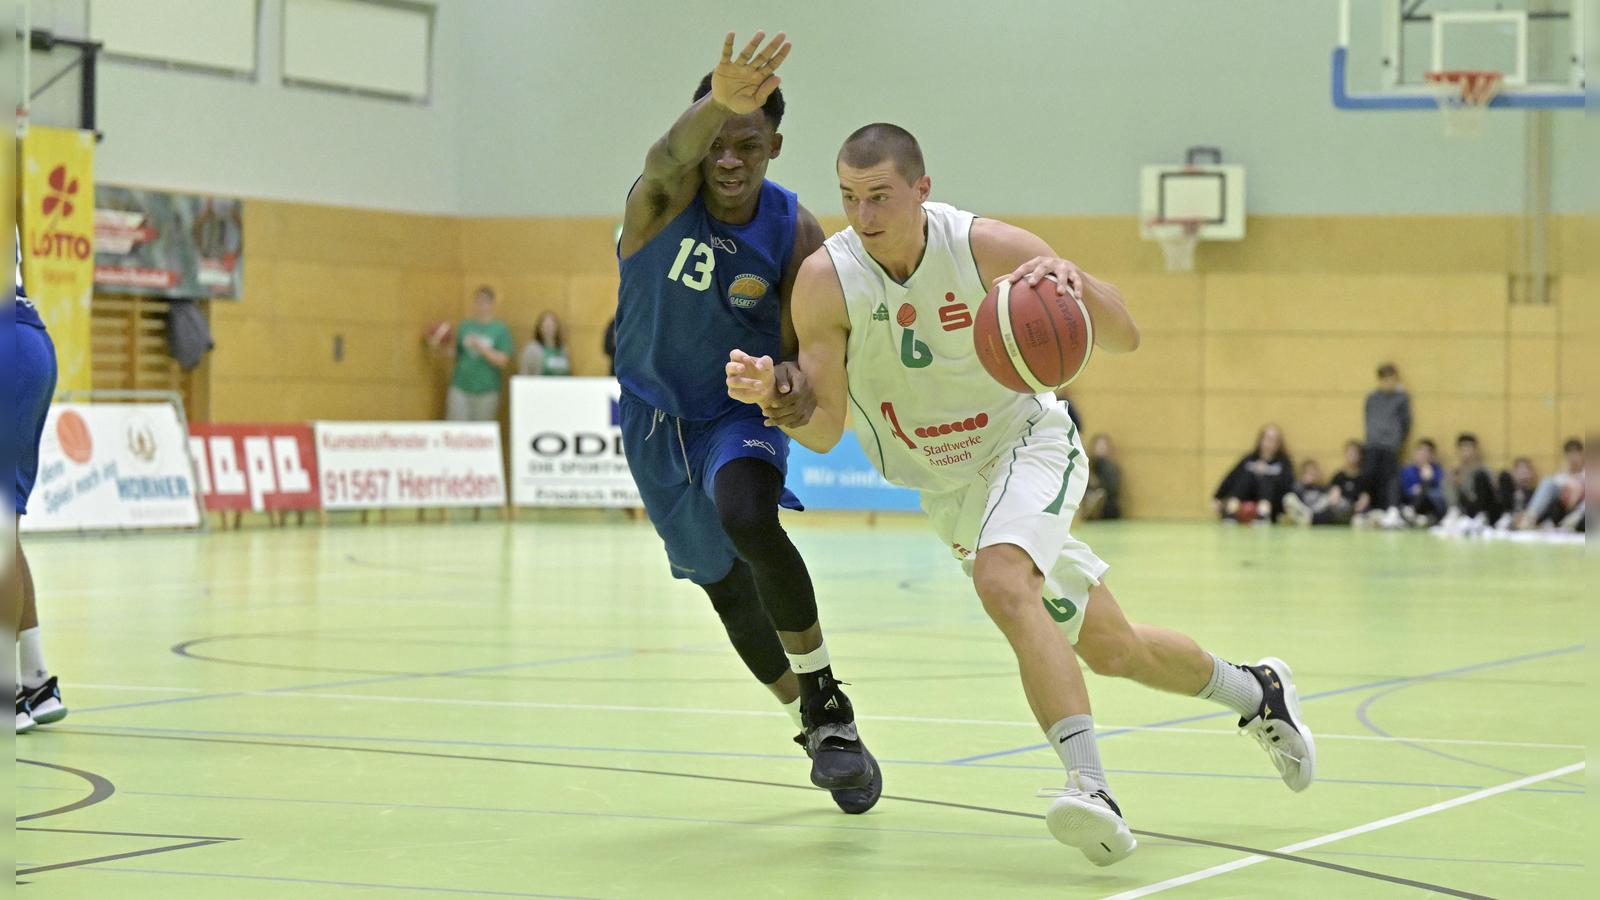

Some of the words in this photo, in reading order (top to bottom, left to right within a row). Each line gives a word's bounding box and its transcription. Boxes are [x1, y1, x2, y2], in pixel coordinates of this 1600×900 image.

[31, 232, 91, 261] LOTTO
[667, 238, 716, 291] 13
[923, 435, 983, 456] Stadtwerke
[929, 451, 972, 466] Ansbach
[325, 469, 390, 502] 91567
[397, 468, 500, 498] Herrieden
